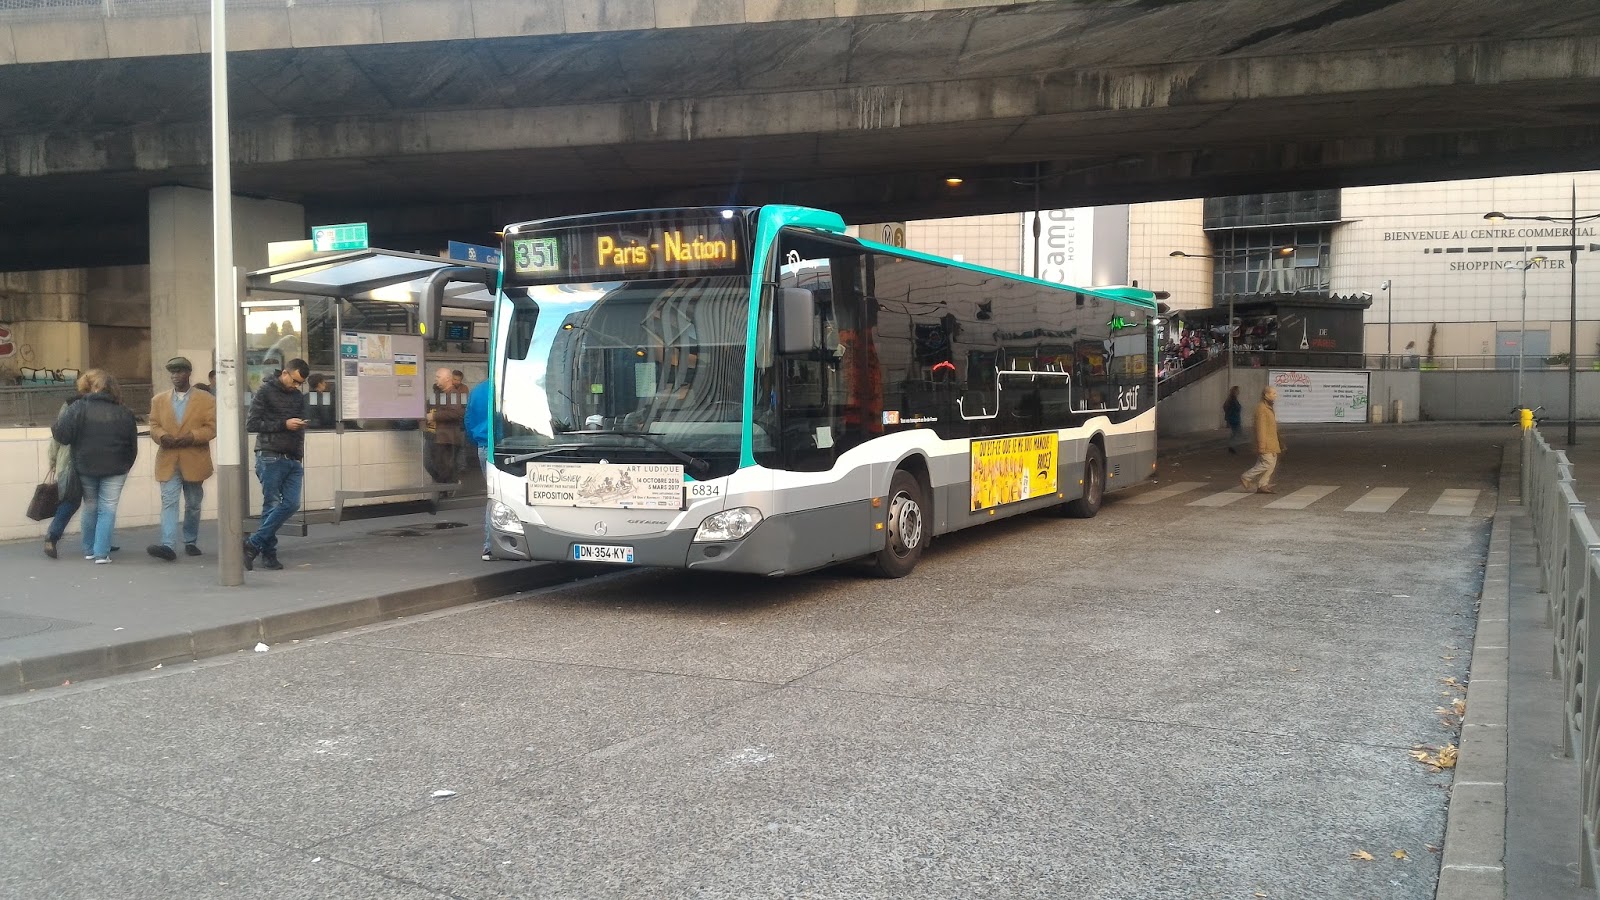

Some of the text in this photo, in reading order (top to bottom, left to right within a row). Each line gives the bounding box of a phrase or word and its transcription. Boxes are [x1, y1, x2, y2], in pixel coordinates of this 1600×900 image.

[1384, 227, 1597, 241] BIENVENUE AU CENTRE COMMERCIAL
[517, 241, 556, 268] 351
[597, 235, 647, 266] Paris
[664, 230, 726, 262] Nation
[1319, 328, 1328, 336] DE
[1312, 339, 1337, 348] PARIS
[533, 491, 574, 501] EXPOSITION
[692, 484, 720, 497] 6834
[580, 546, 626, 560] DN-354-KY
